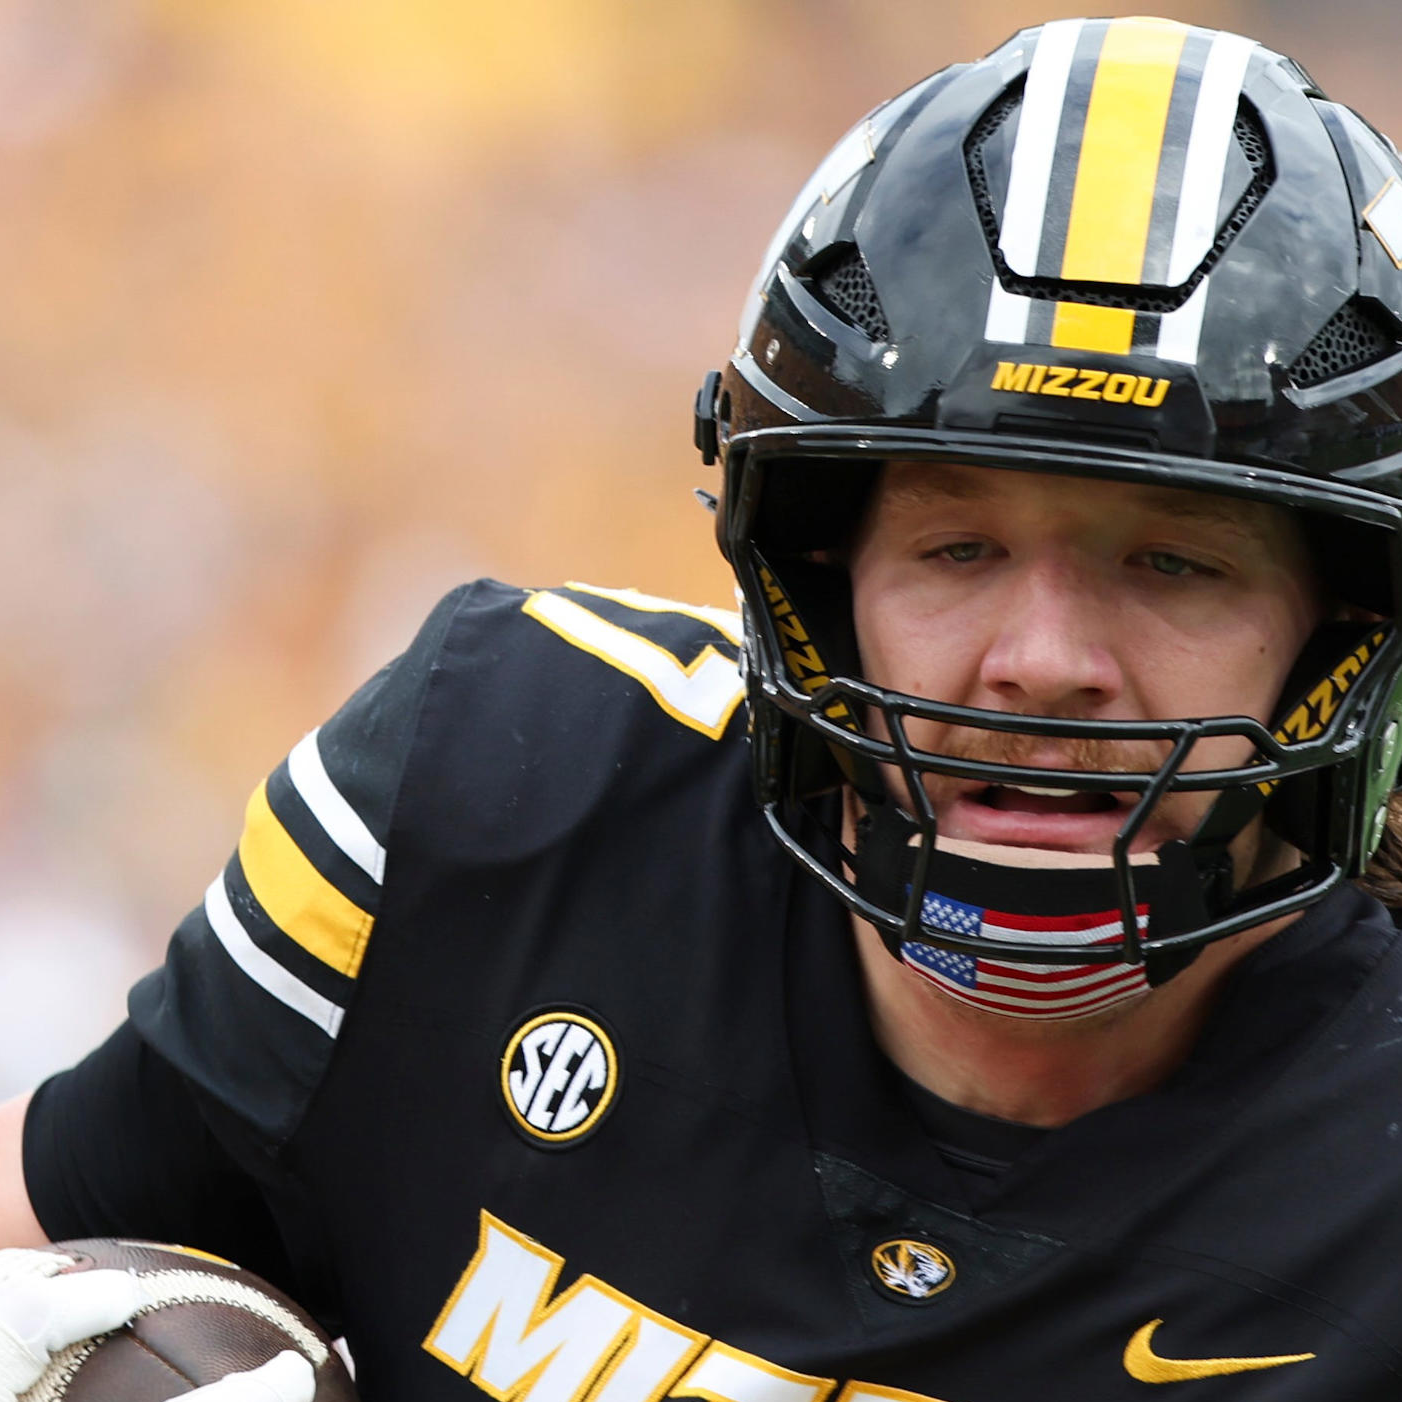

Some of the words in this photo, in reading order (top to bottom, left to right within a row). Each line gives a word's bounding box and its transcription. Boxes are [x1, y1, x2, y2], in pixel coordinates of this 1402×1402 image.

[990, 361, 1171, 408] MIZZOU
[758, 564, 860, 733] MIZZ
[509, 1022, 607, 1132] SEC
